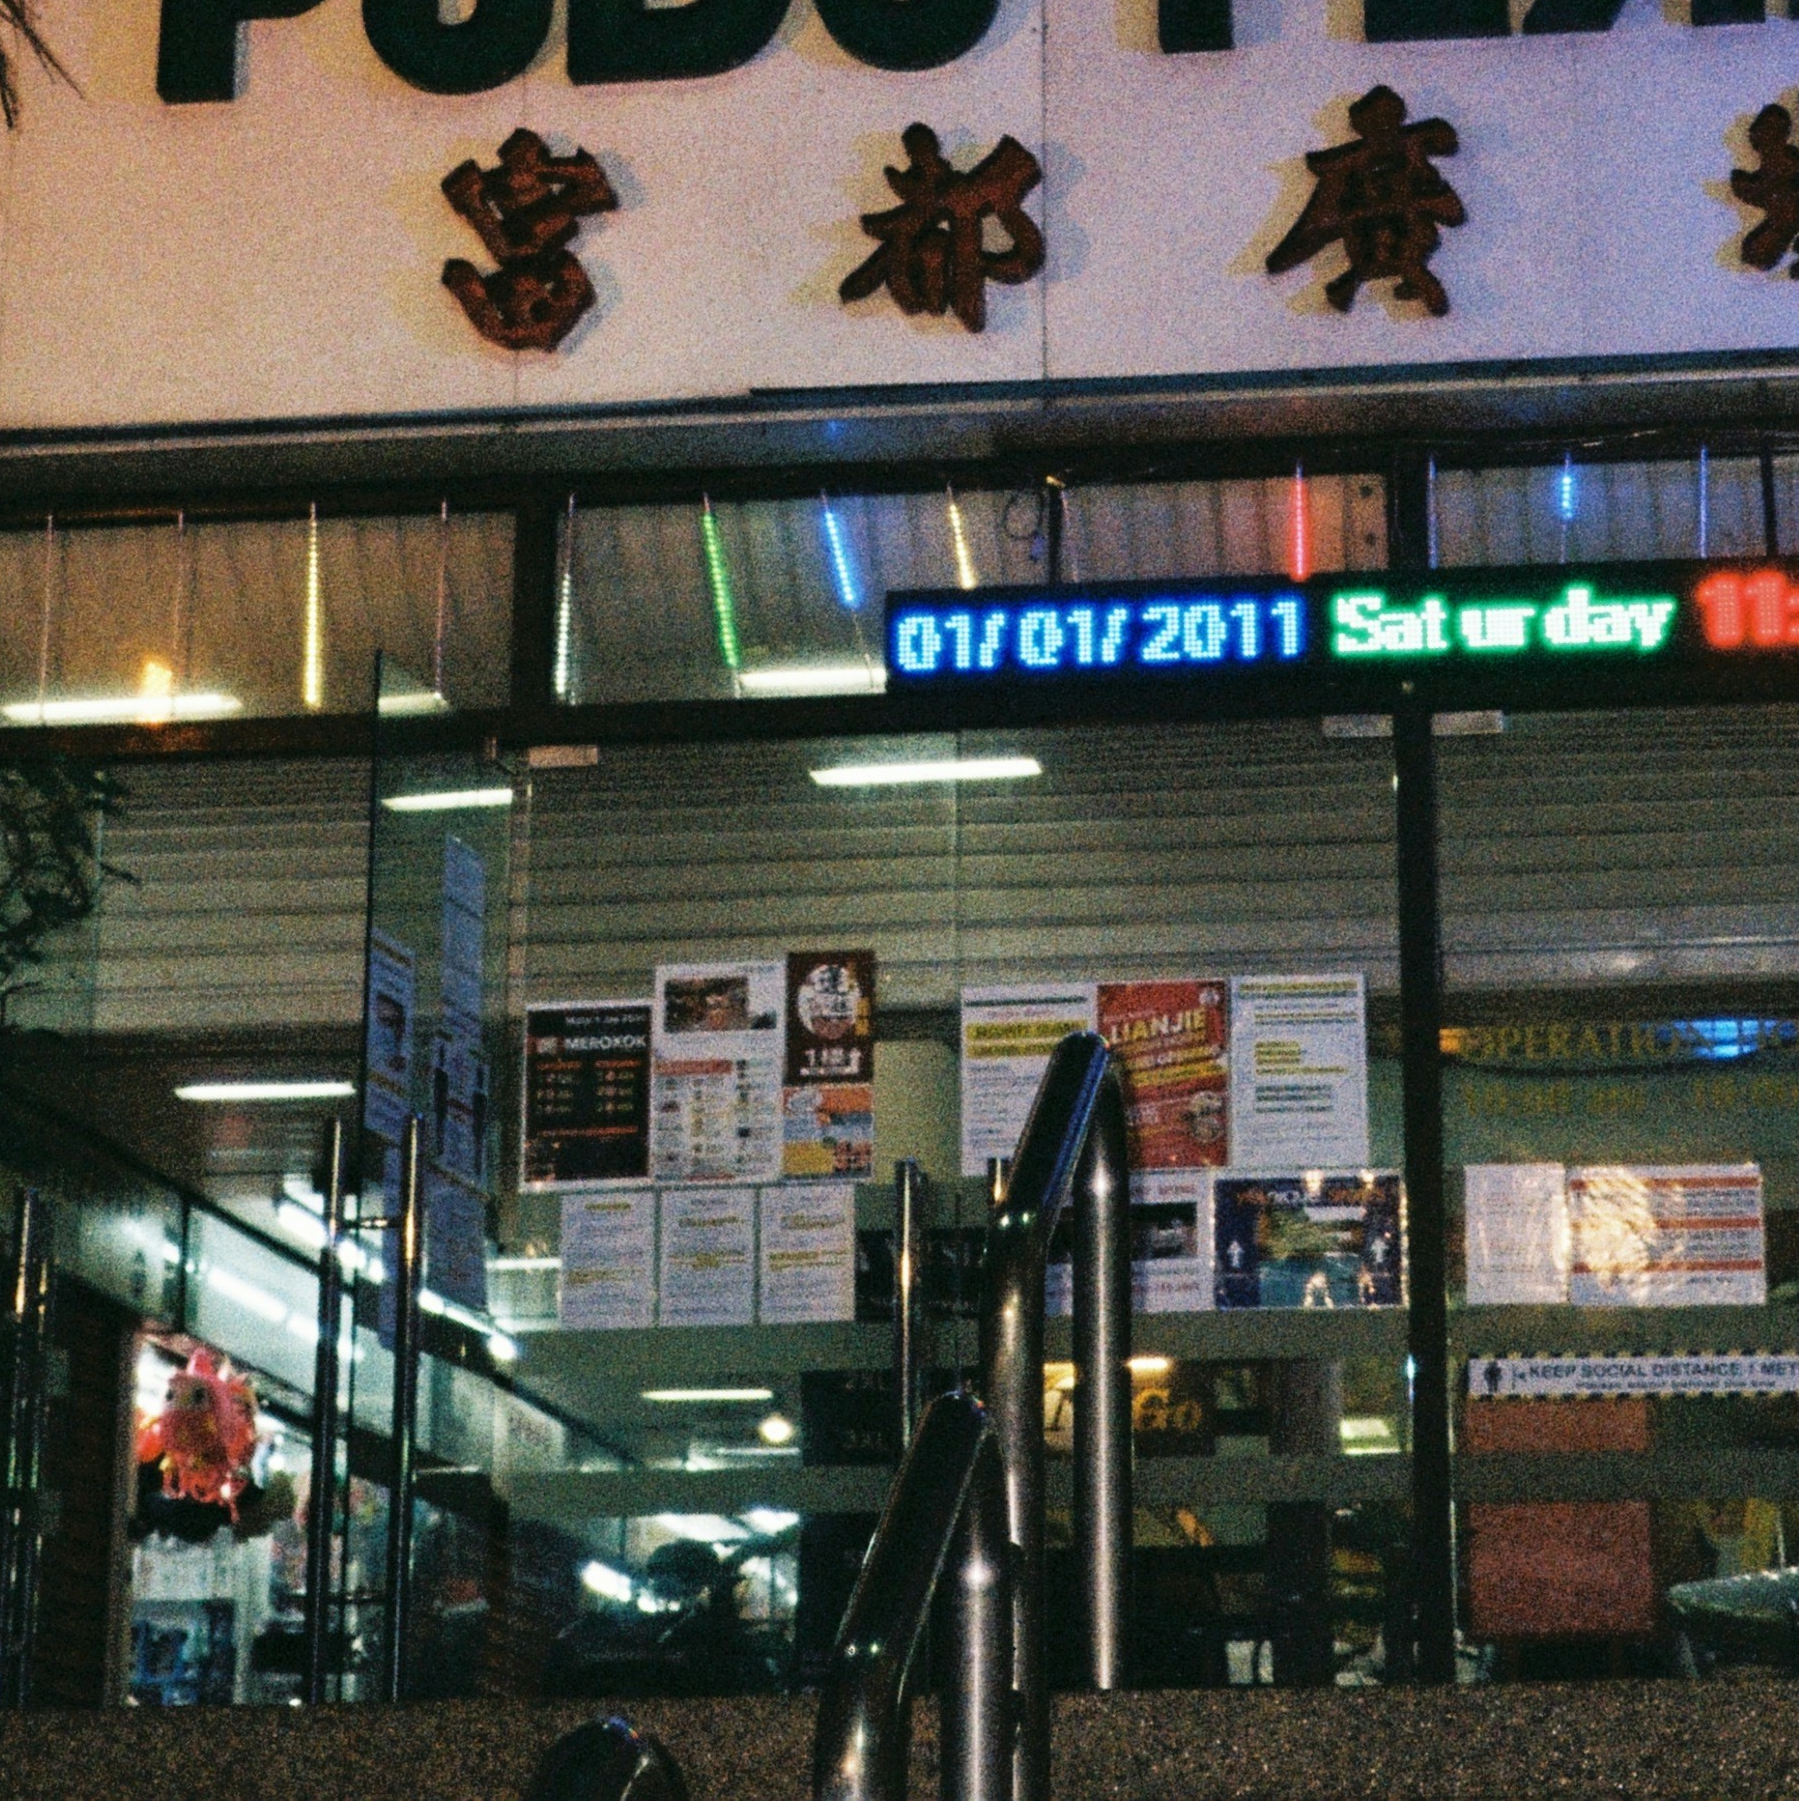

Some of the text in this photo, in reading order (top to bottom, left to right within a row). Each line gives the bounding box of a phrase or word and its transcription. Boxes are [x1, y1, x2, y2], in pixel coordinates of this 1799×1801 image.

[1333, 586, 1675, 655] Saturday
[1109, 1007, 1207, 1044] LIANJIE
[563, 1034, 647, 1050] MEROKOK
[1528, 1365, 1577, 1379] KEEP
[1581, 1363, 1647, 1378] SOCIAL
[1652, 1362, 1740, 1378] DISTANCE
